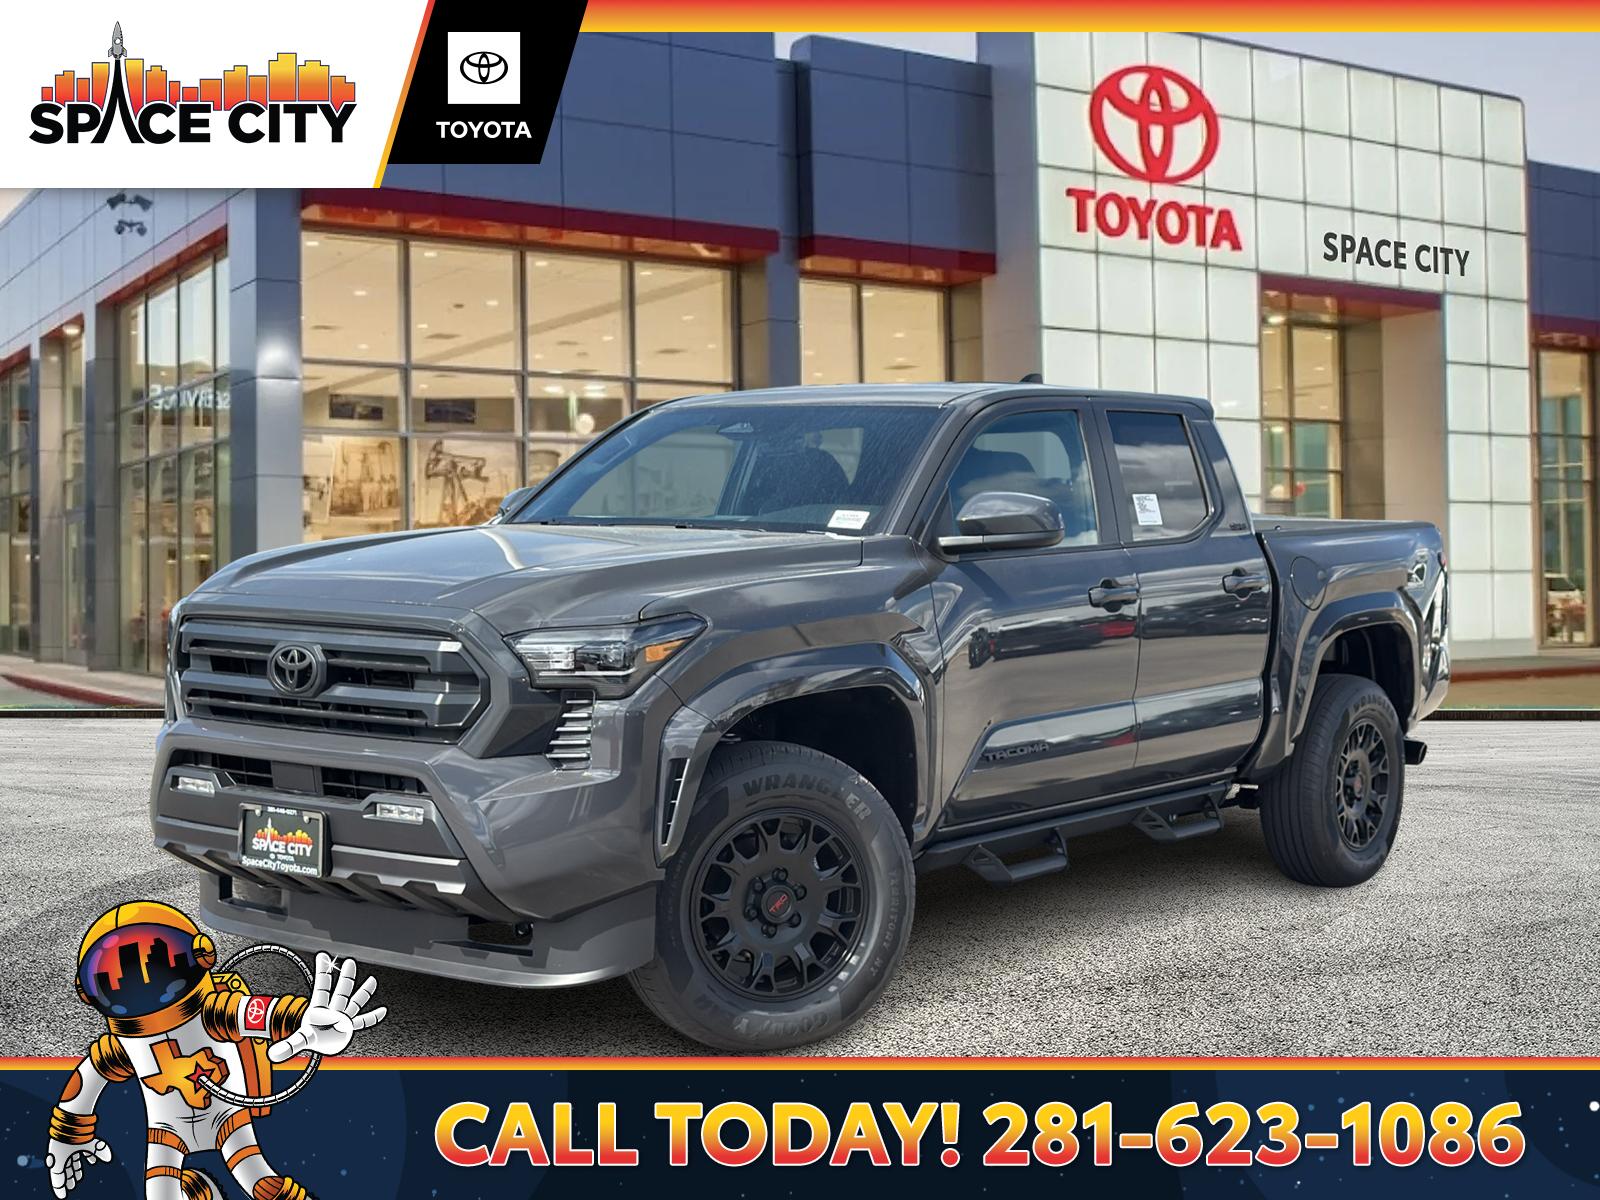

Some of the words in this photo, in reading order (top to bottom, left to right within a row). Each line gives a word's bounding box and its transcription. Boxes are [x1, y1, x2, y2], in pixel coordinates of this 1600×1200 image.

[1066, 188, 1243, 251] TOYOTA
[1323, 231, 1407, 270] SPACE
[1415, 244, 1470, 277] CITY
[984, 743, 1049, 761] TACOMA
[252, 833, 286, 854] SPACE
[287, 842, 313, 857] CITY
[241, 855, 318, 876] SpaceCityToyota.com
